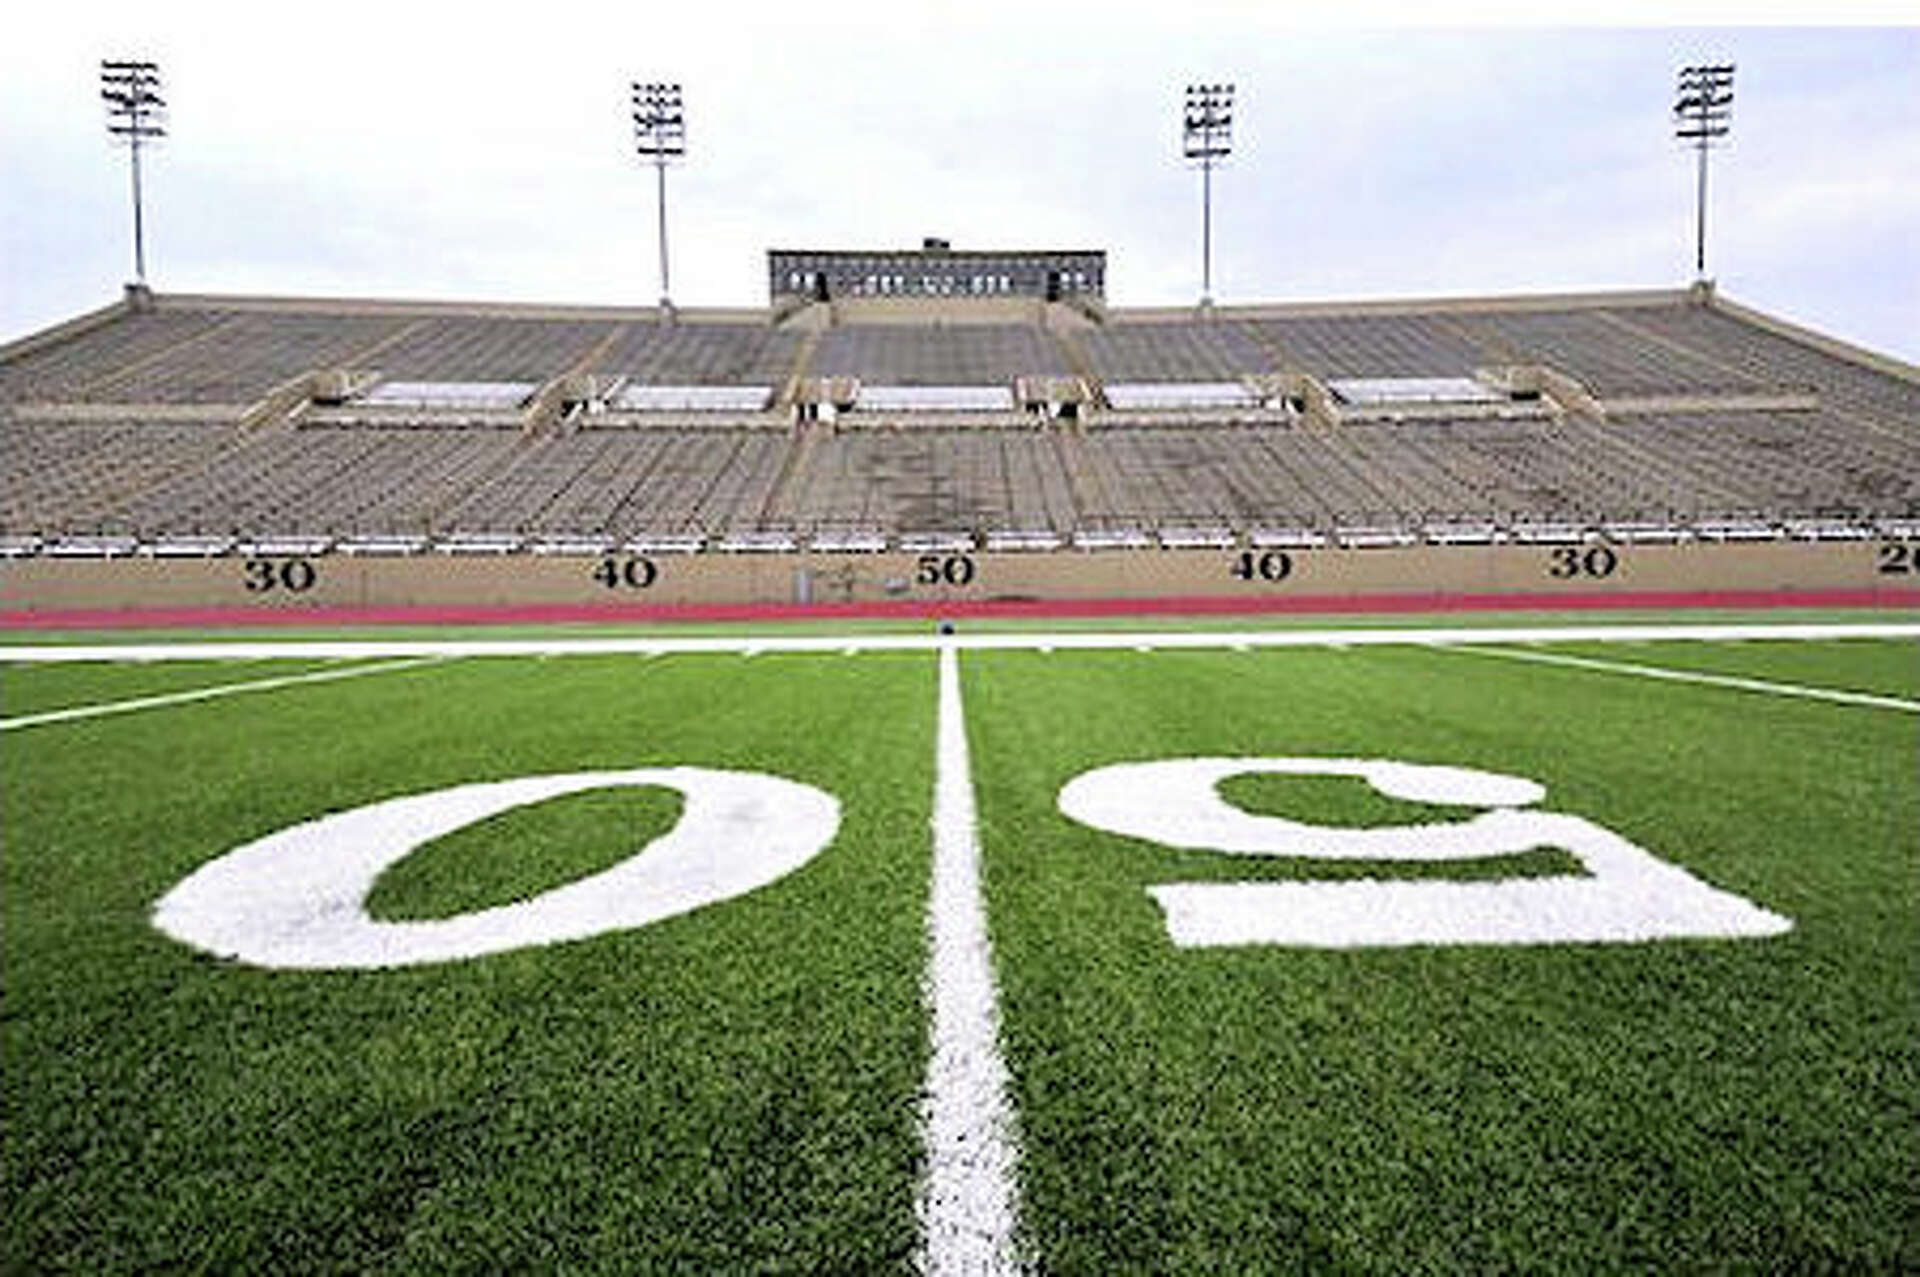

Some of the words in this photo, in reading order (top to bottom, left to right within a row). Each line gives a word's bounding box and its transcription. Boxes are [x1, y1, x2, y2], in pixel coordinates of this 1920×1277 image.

[594, 557, 657, 588] 40
[917, 555, 974, 586] 50
[1230, 551, 1292, 582] 40
[1551, 547, 1618, 579] 30
[1879, 545, 1920, 574] 2
[245, 559, 316, 593] 30
